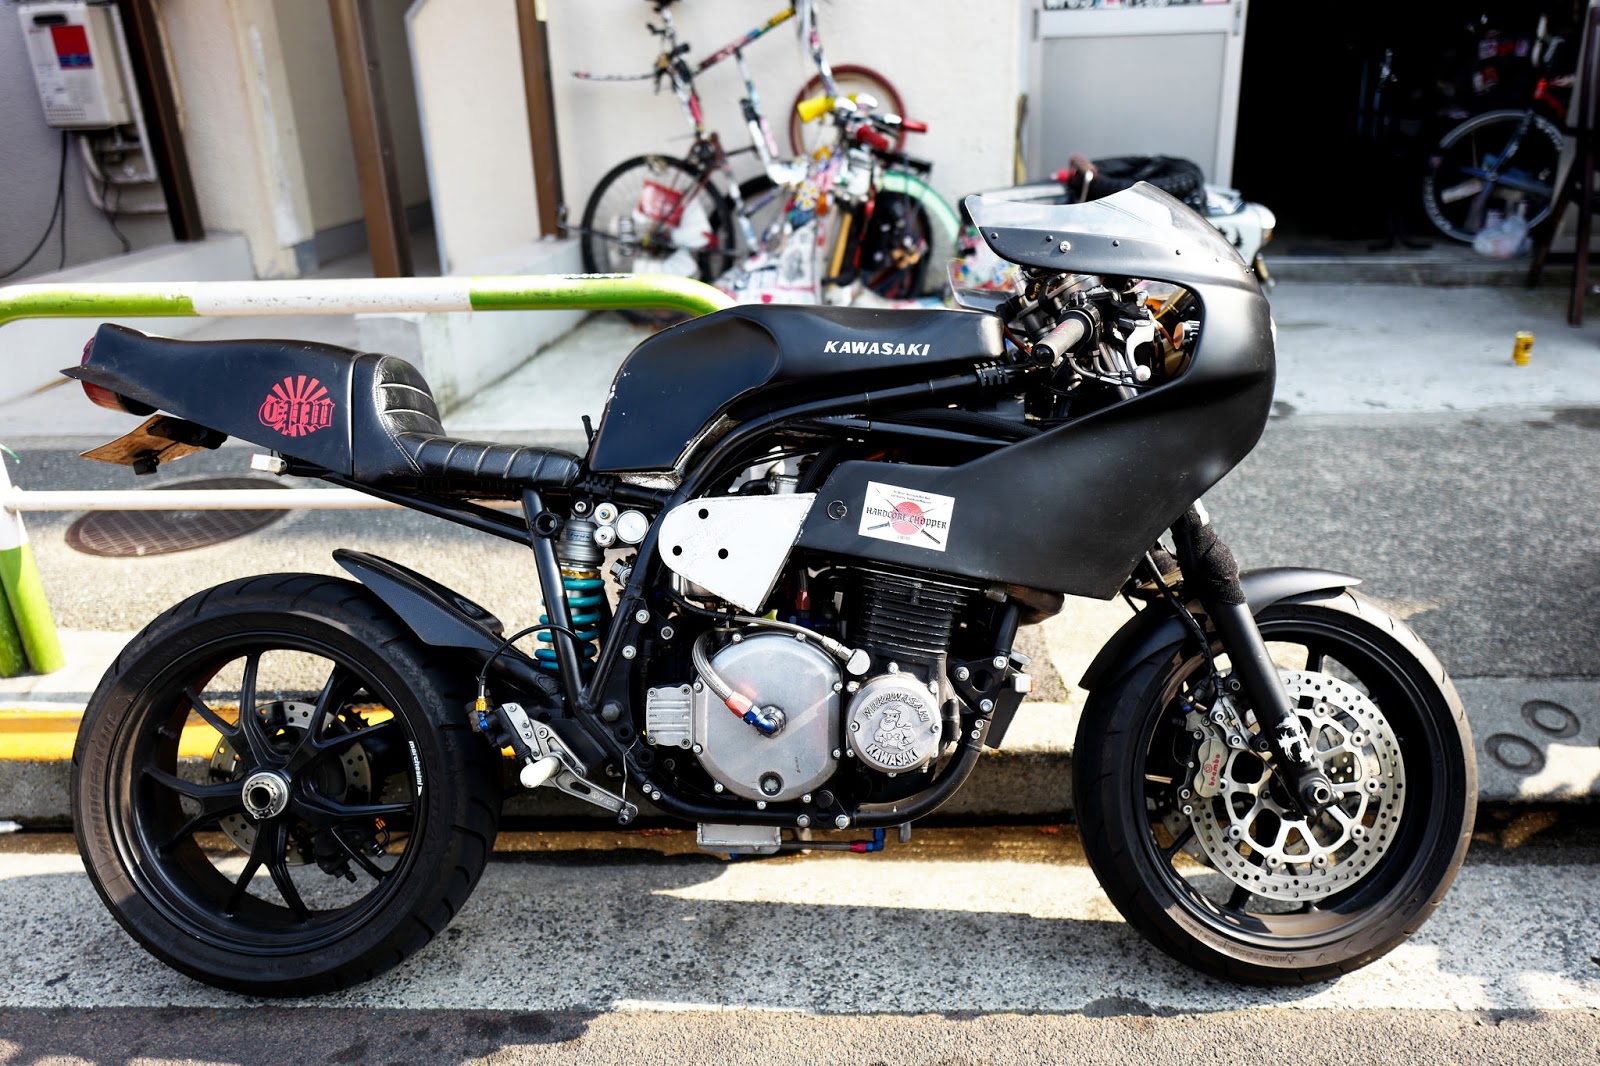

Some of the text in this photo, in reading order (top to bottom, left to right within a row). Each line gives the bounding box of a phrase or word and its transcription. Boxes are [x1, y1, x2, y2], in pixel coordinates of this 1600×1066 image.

[823, 340, 931, 356] KAWASAKI
[866, 506, 947, 530] HARDCORE CHOPPER
[408, 740, 424, 786] marchesini
[865, 743, 920, 767] KAWASAKI
[1208, 753, 1221, 787] brembo
